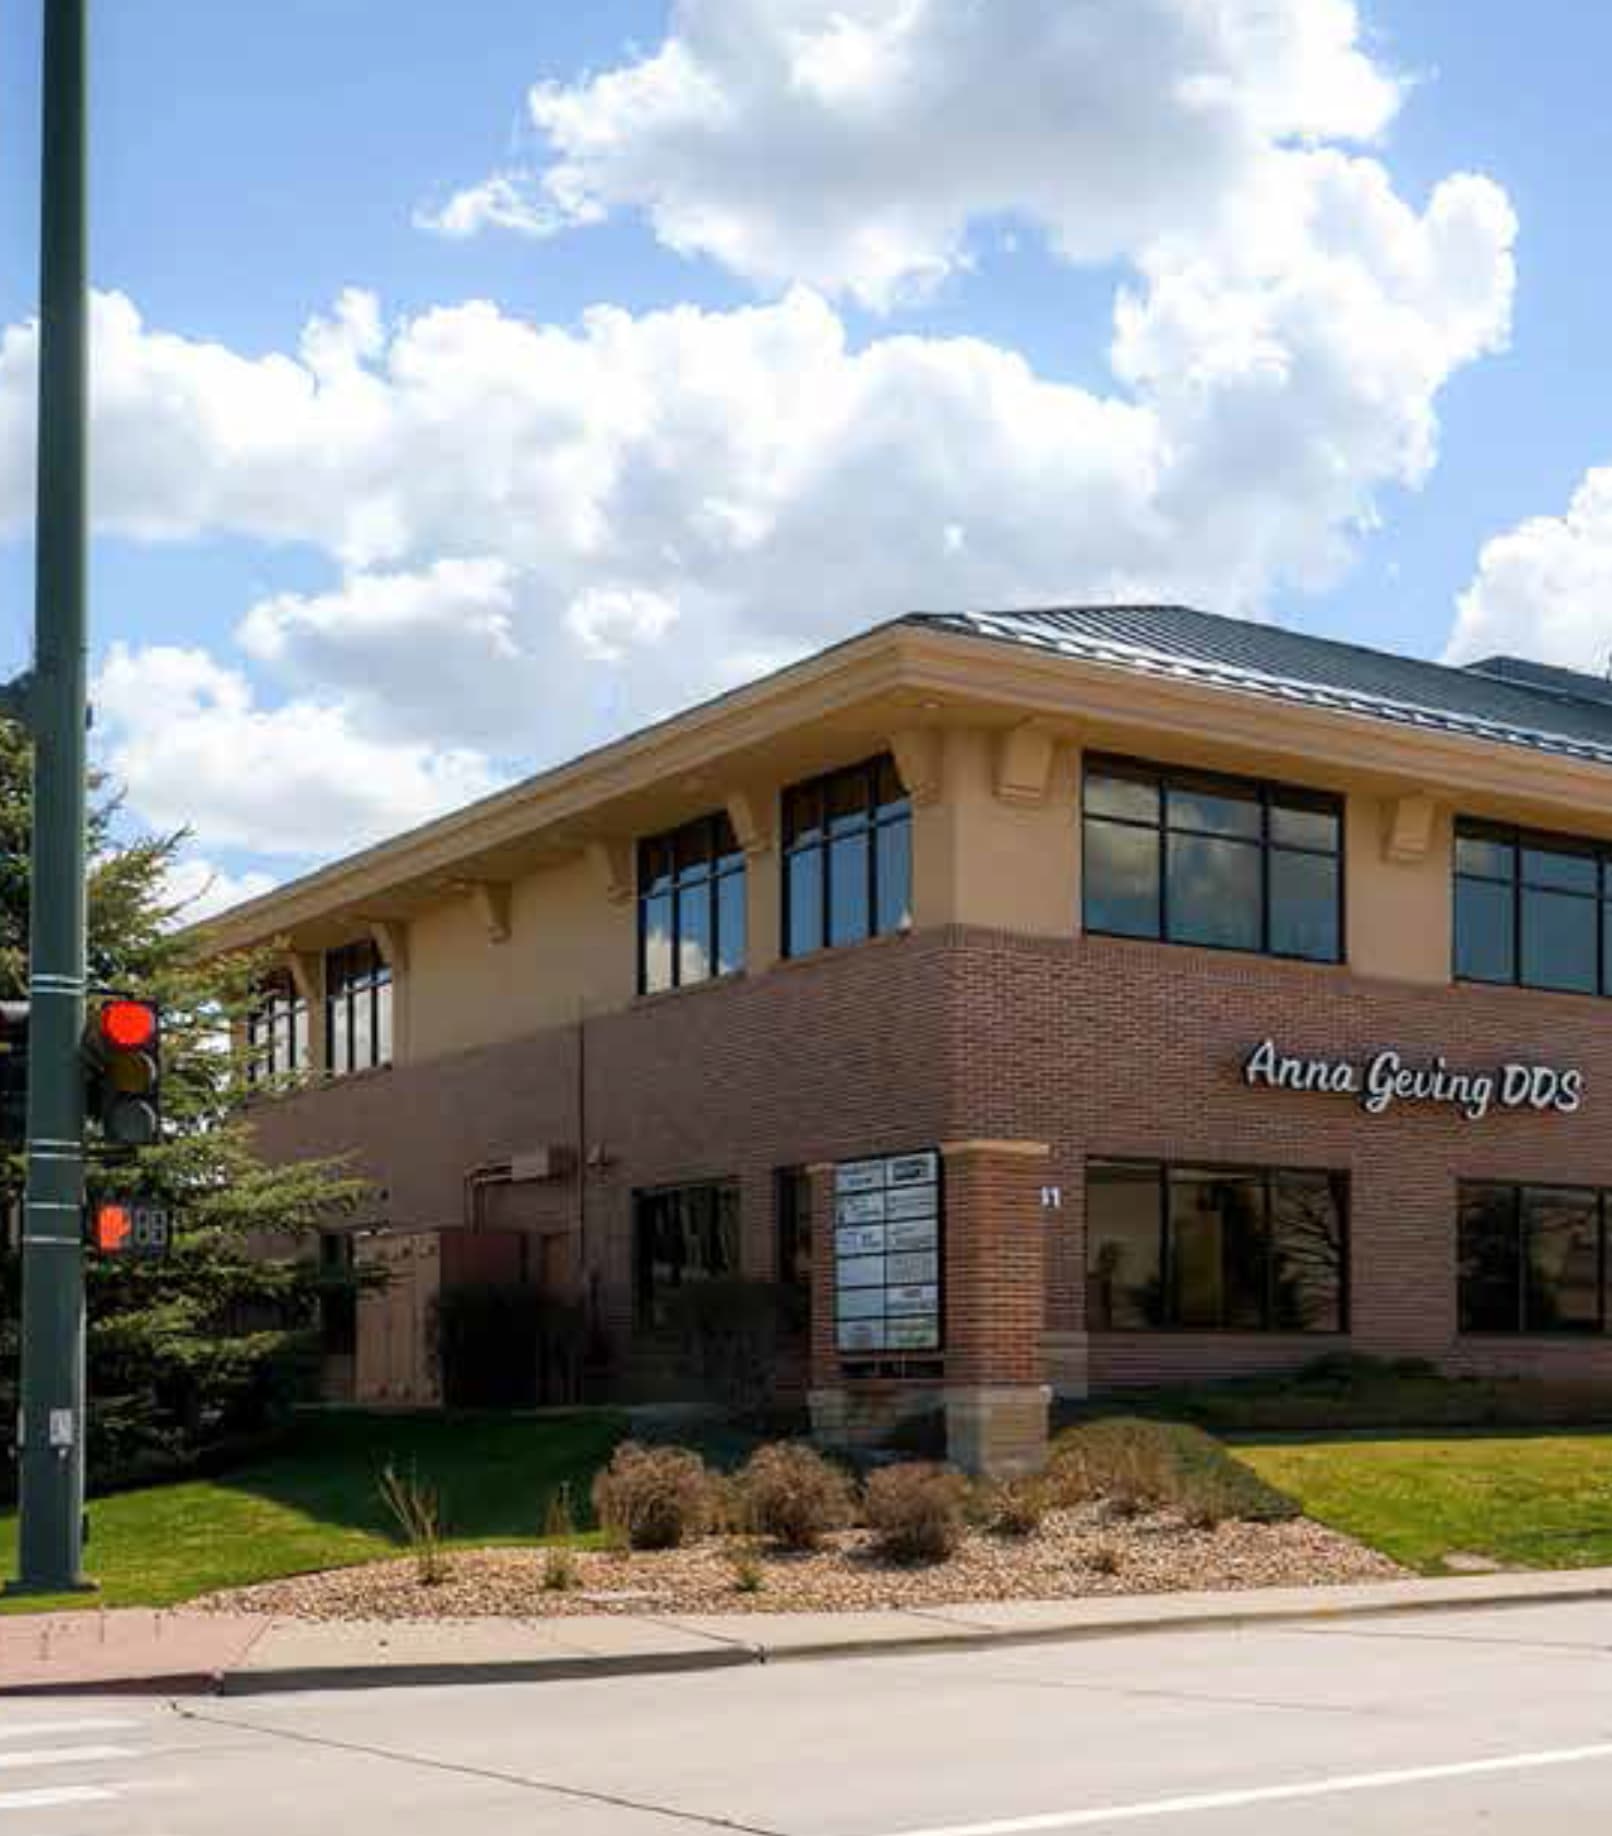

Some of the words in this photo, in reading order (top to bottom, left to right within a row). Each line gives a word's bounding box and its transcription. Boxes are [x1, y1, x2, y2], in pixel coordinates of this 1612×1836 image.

[1246, 1038, 1357, 1093] Anna
[1364, 1050, 1493, 1120] Geving
[1499, 1064, 1584, 1113] DDS
